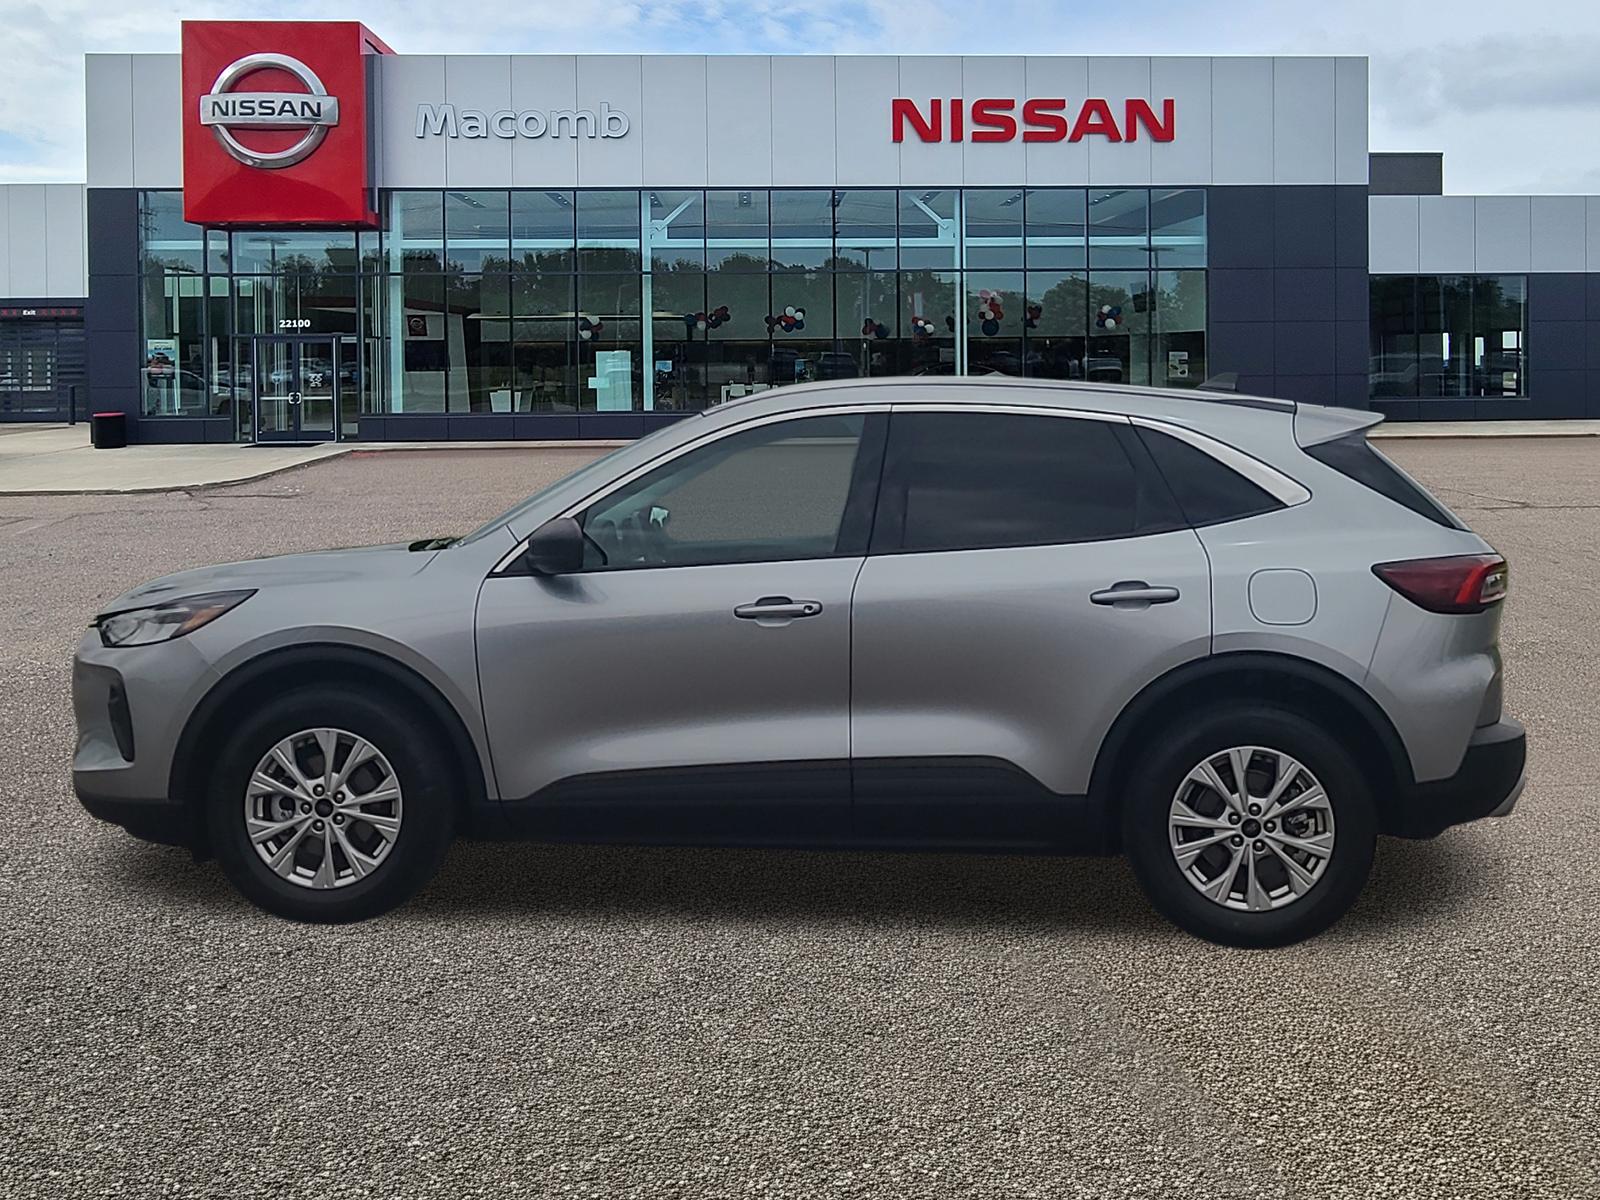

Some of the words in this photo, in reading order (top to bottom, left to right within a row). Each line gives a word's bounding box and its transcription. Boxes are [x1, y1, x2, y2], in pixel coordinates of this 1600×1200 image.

[211, 100, 322, 118] NISSAN
[415, 101, 630, 139] Macomb
[892, 98, 1175, 142] NISSAN
[279, 319, 311, 328] 22100
